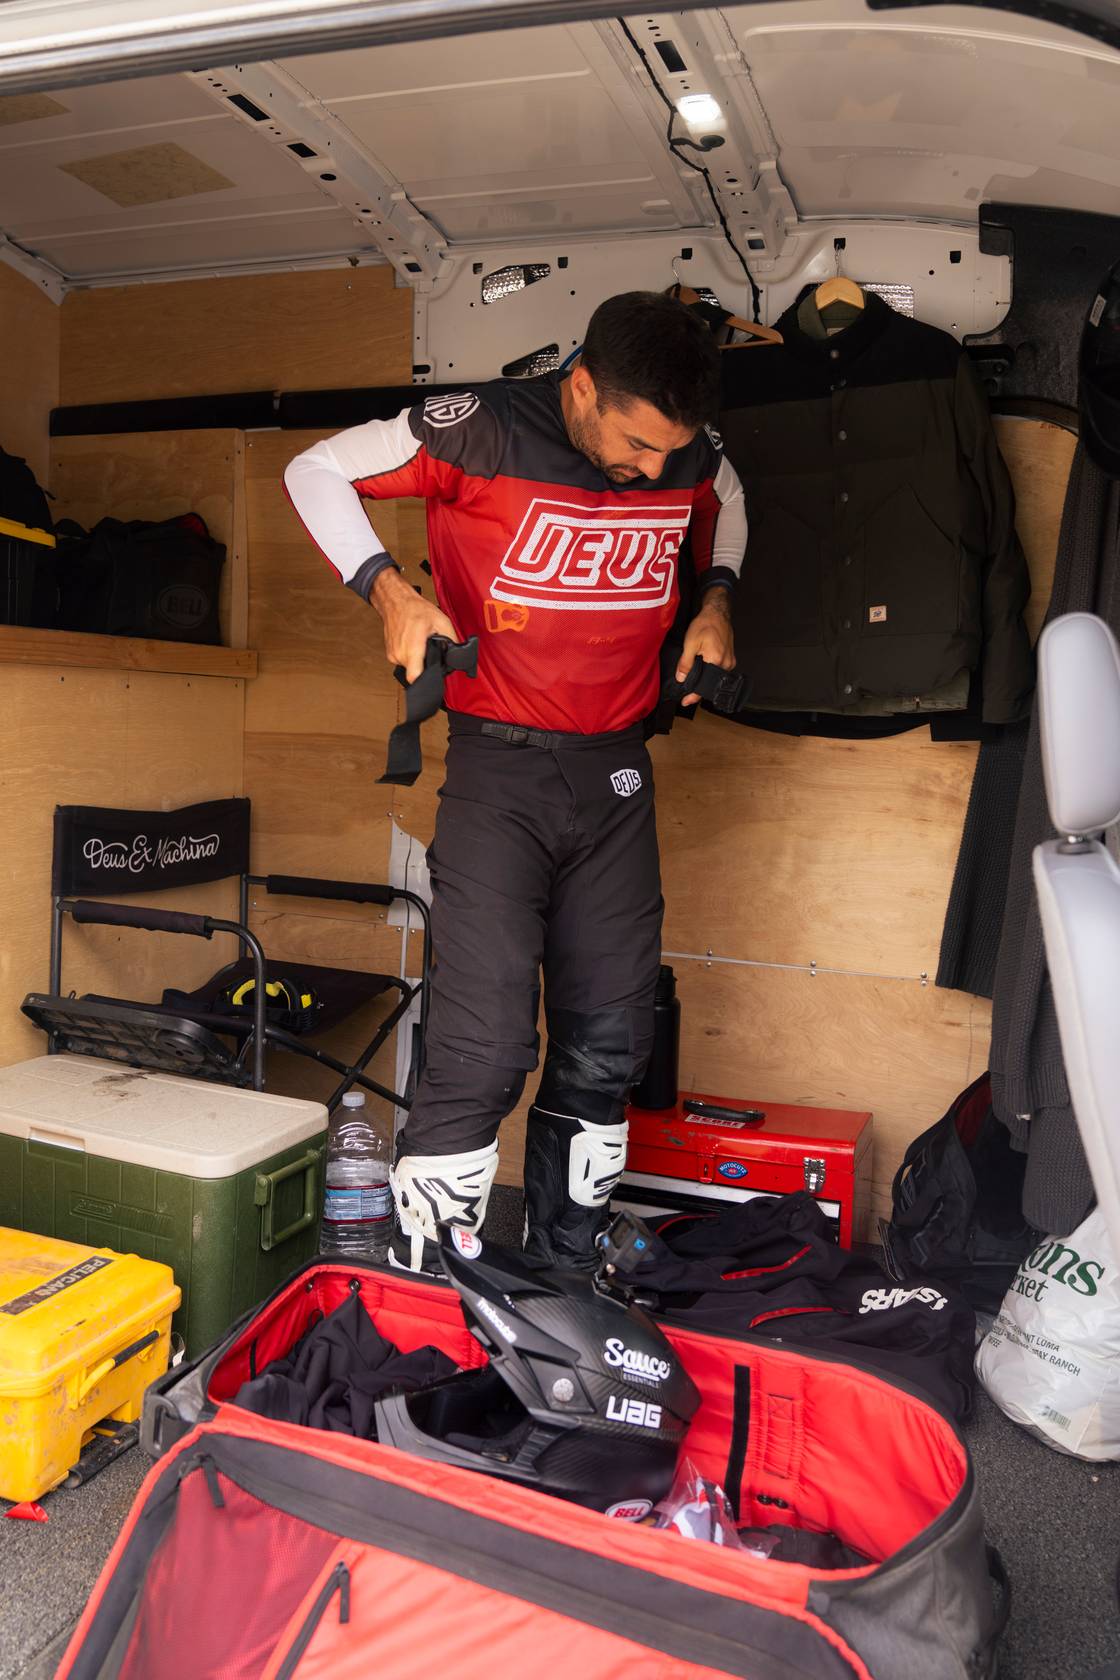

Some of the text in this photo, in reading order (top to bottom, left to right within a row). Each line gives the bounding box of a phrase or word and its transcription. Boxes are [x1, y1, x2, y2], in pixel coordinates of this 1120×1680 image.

[495, 501, 690, 603] DEUS
[612, 771, 640, 794] DEUS
[83, 833, 220, 873] Deus Ex Machina
[43, 1258, 106, 1297] PELICAN
[1020, 1241, 1105, 1296] ons
[603, 1338, 671, 1380] Sauce
[1049, 1354, 1081, 1376] RANCH
[614, 1506, 645, 1518] BELL
